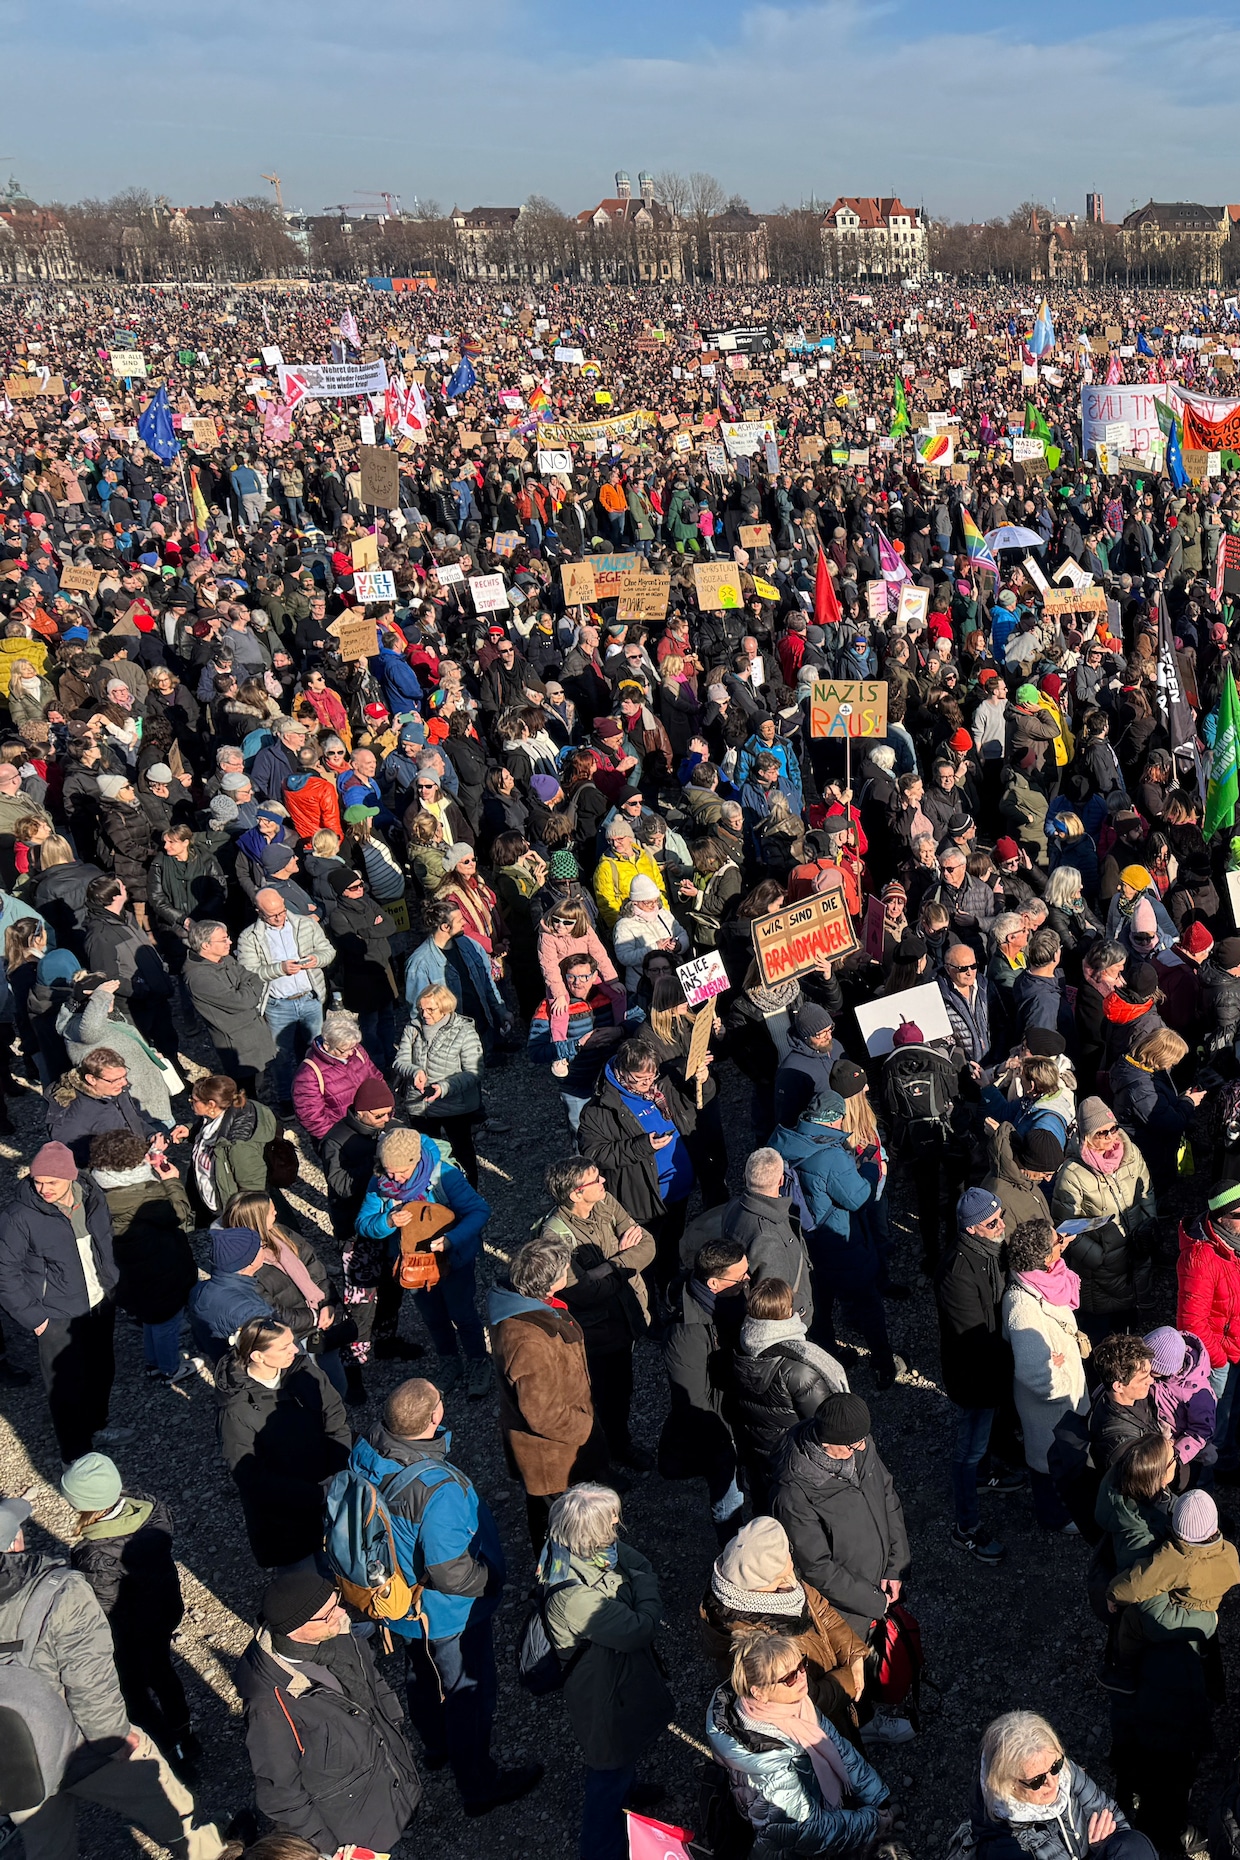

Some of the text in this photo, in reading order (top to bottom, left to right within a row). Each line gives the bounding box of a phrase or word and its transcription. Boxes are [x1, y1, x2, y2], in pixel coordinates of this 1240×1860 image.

[357, 573, 392, 585] VIEL
[474, 578, 500, 589] RECHTS
[358, 584, 393, 596] FALT
[762, 896, 839, 936] WIR SIND DIE
[764, 917, 850, 978] BRANDMAUER!
[679, 957, 710, 981] ALICE
[682, 976, 703, 993] INS
